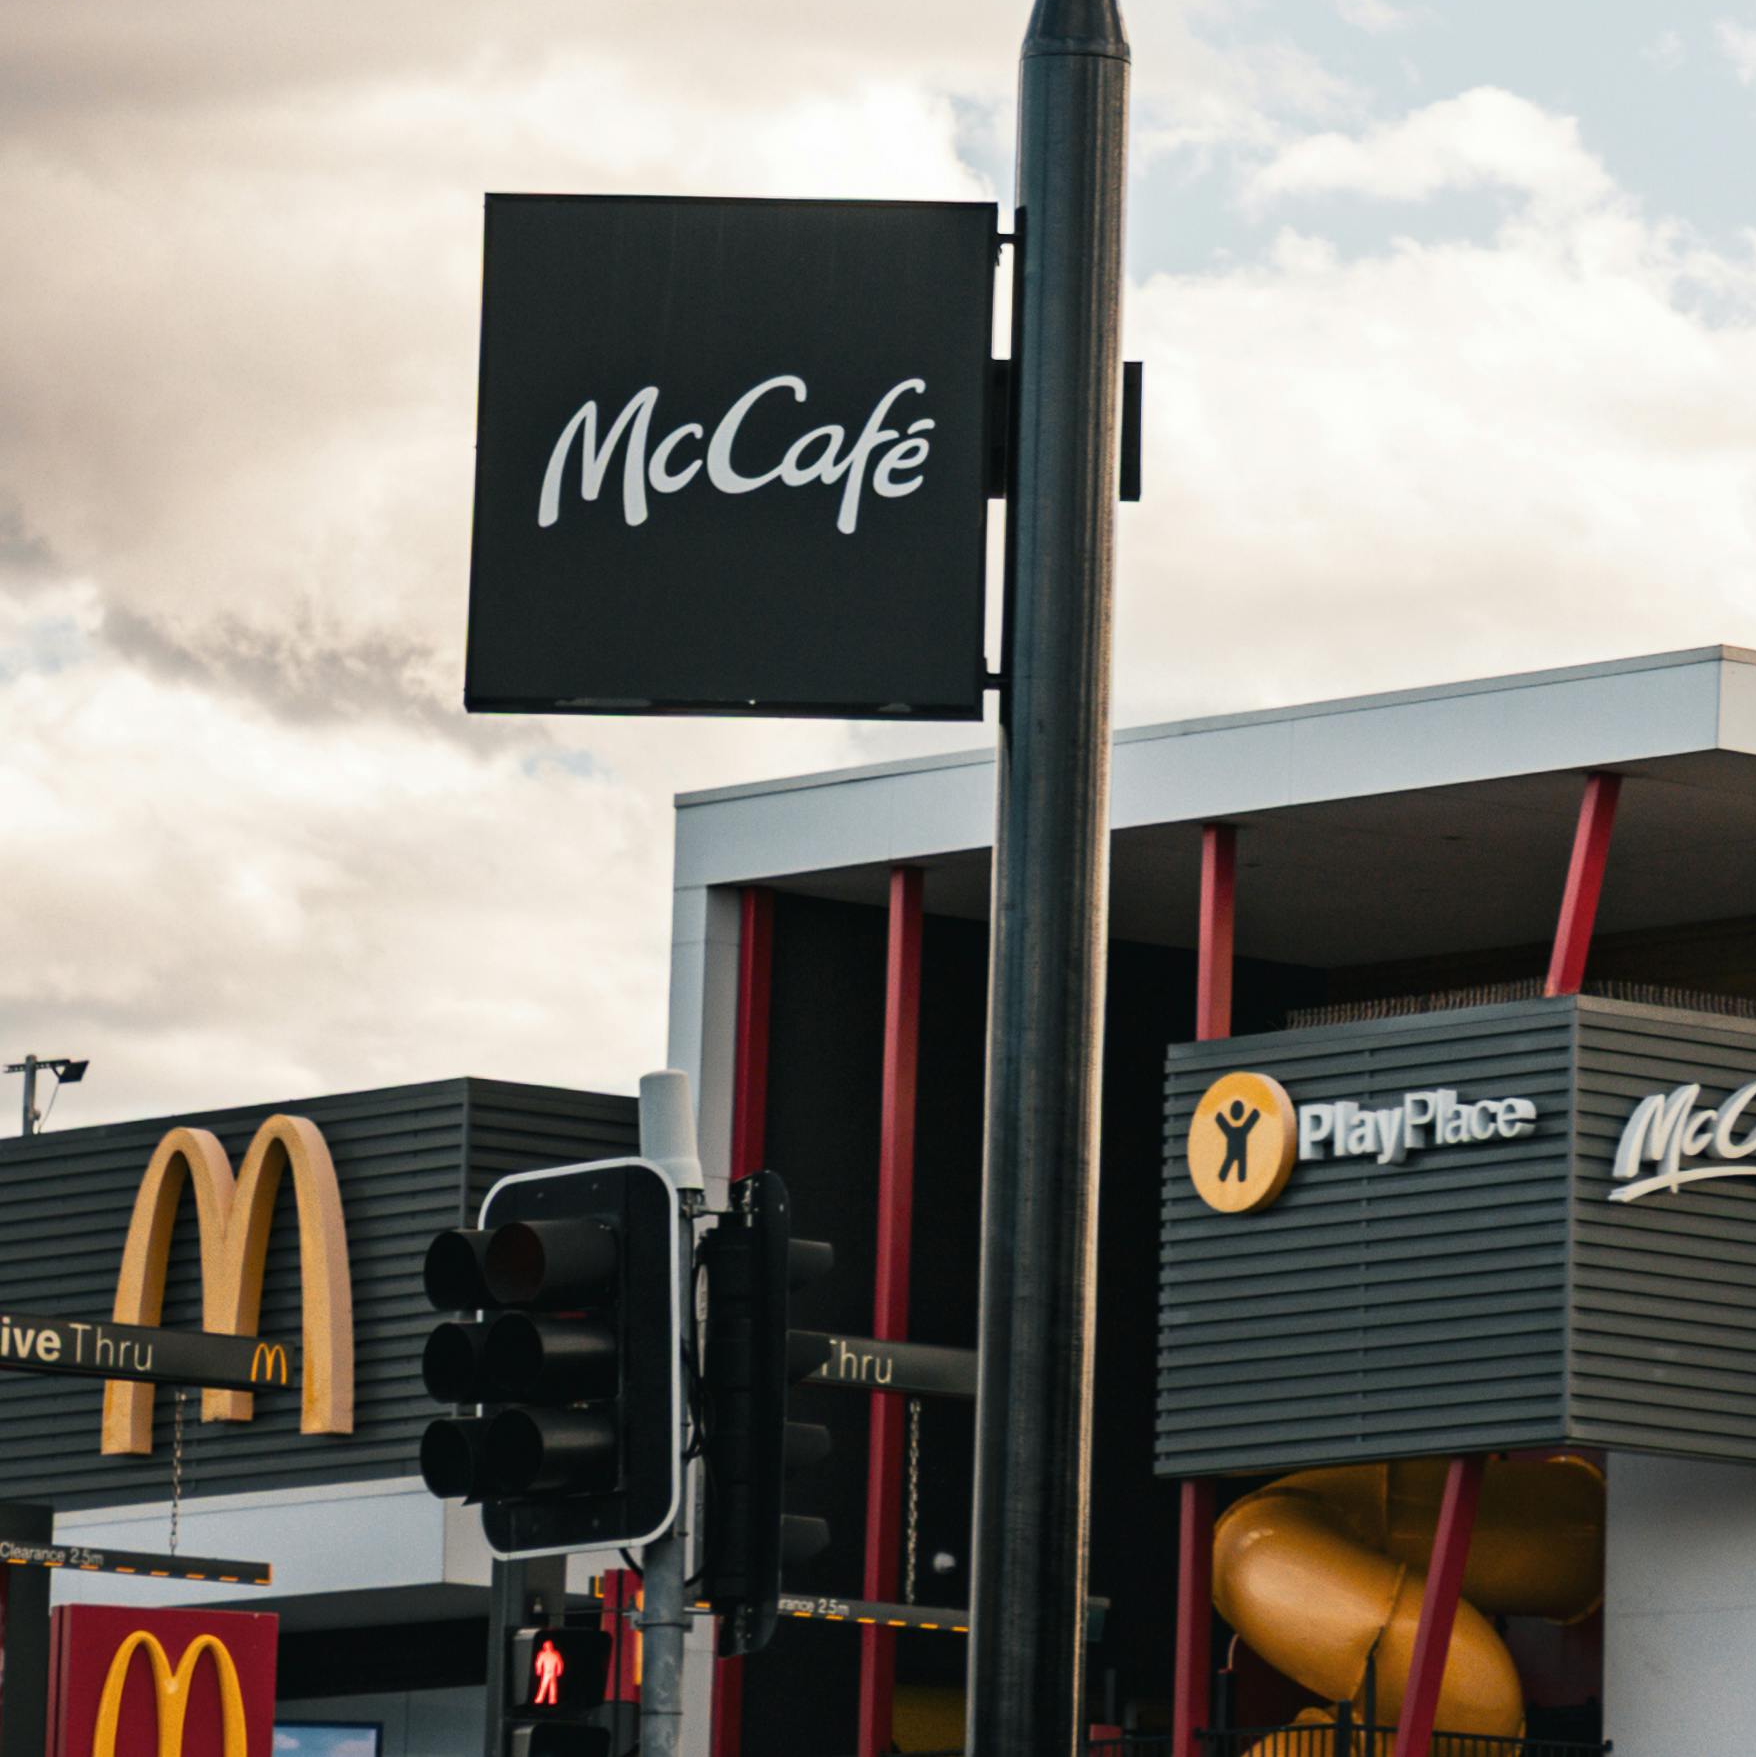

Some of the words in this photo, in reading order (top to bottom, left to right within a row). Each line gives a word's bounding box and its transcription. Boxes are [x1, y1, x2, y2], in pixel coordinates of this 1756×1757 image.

[538, 375, 935, 535] McCafé
[1299, 1088, 1537, 1165] PlayPlace
[0, 1316, 62, 1362] ive
[69, 1322, 153, 1371] Thru
[0, 1541, 66, 1563] Clearance
